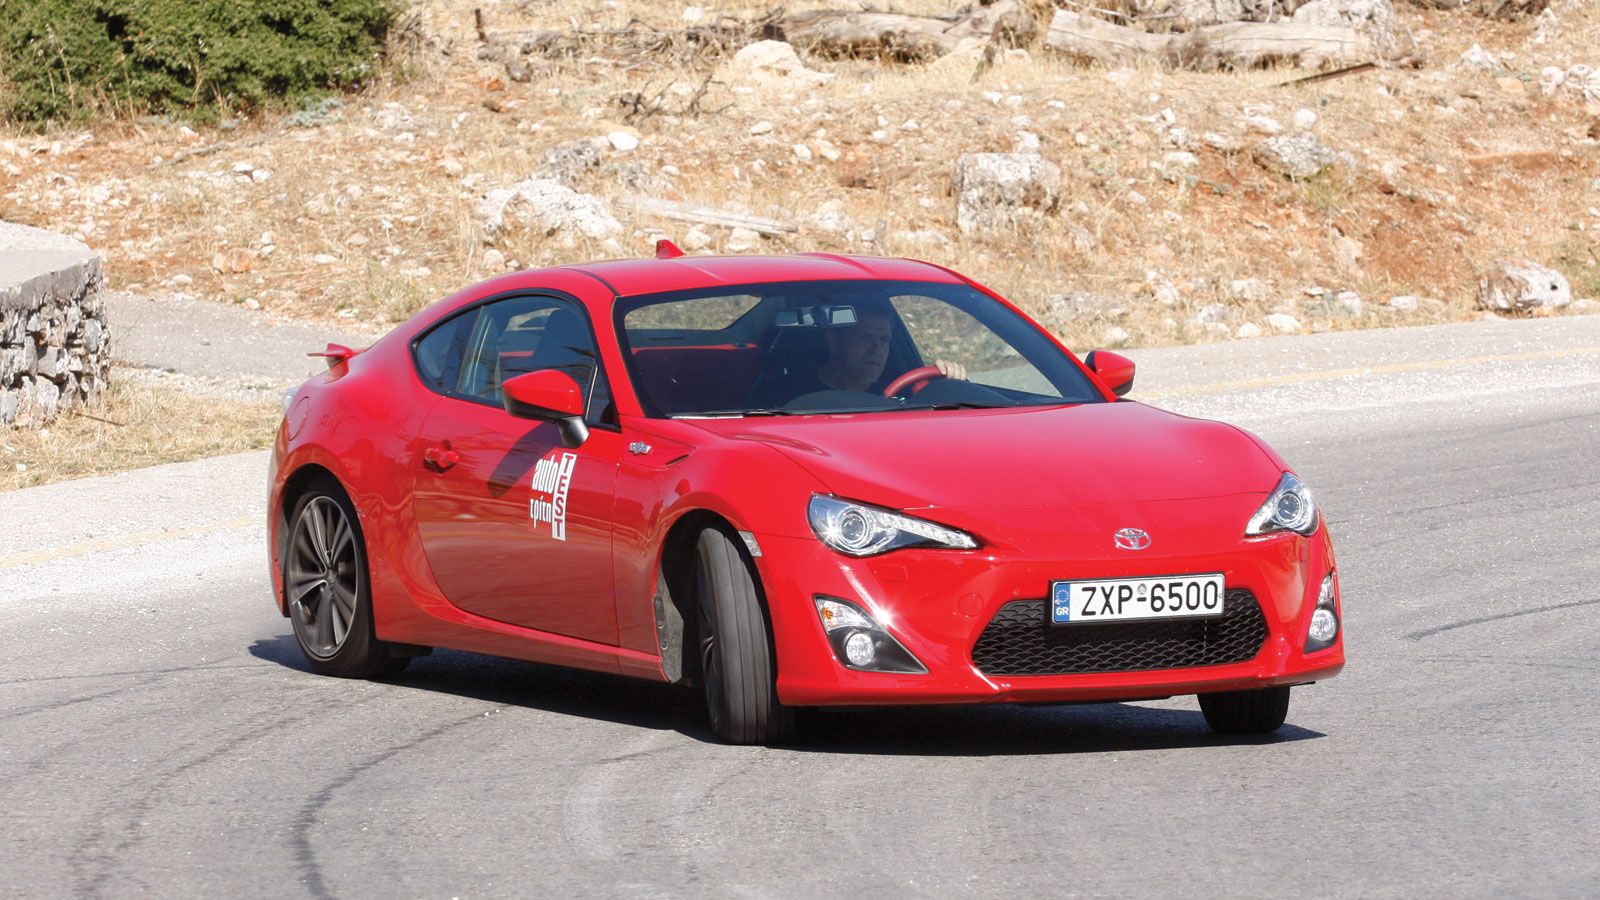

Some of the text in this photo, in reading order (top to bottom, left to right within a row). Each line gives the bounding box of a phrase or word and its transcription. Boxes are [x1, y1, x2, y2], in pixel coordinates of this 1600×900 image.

[553, 453, 574, 538] TEST
[1056, 606, 1069, 616] GR
[1081, 580, 1219, 616] ZXP-6500
